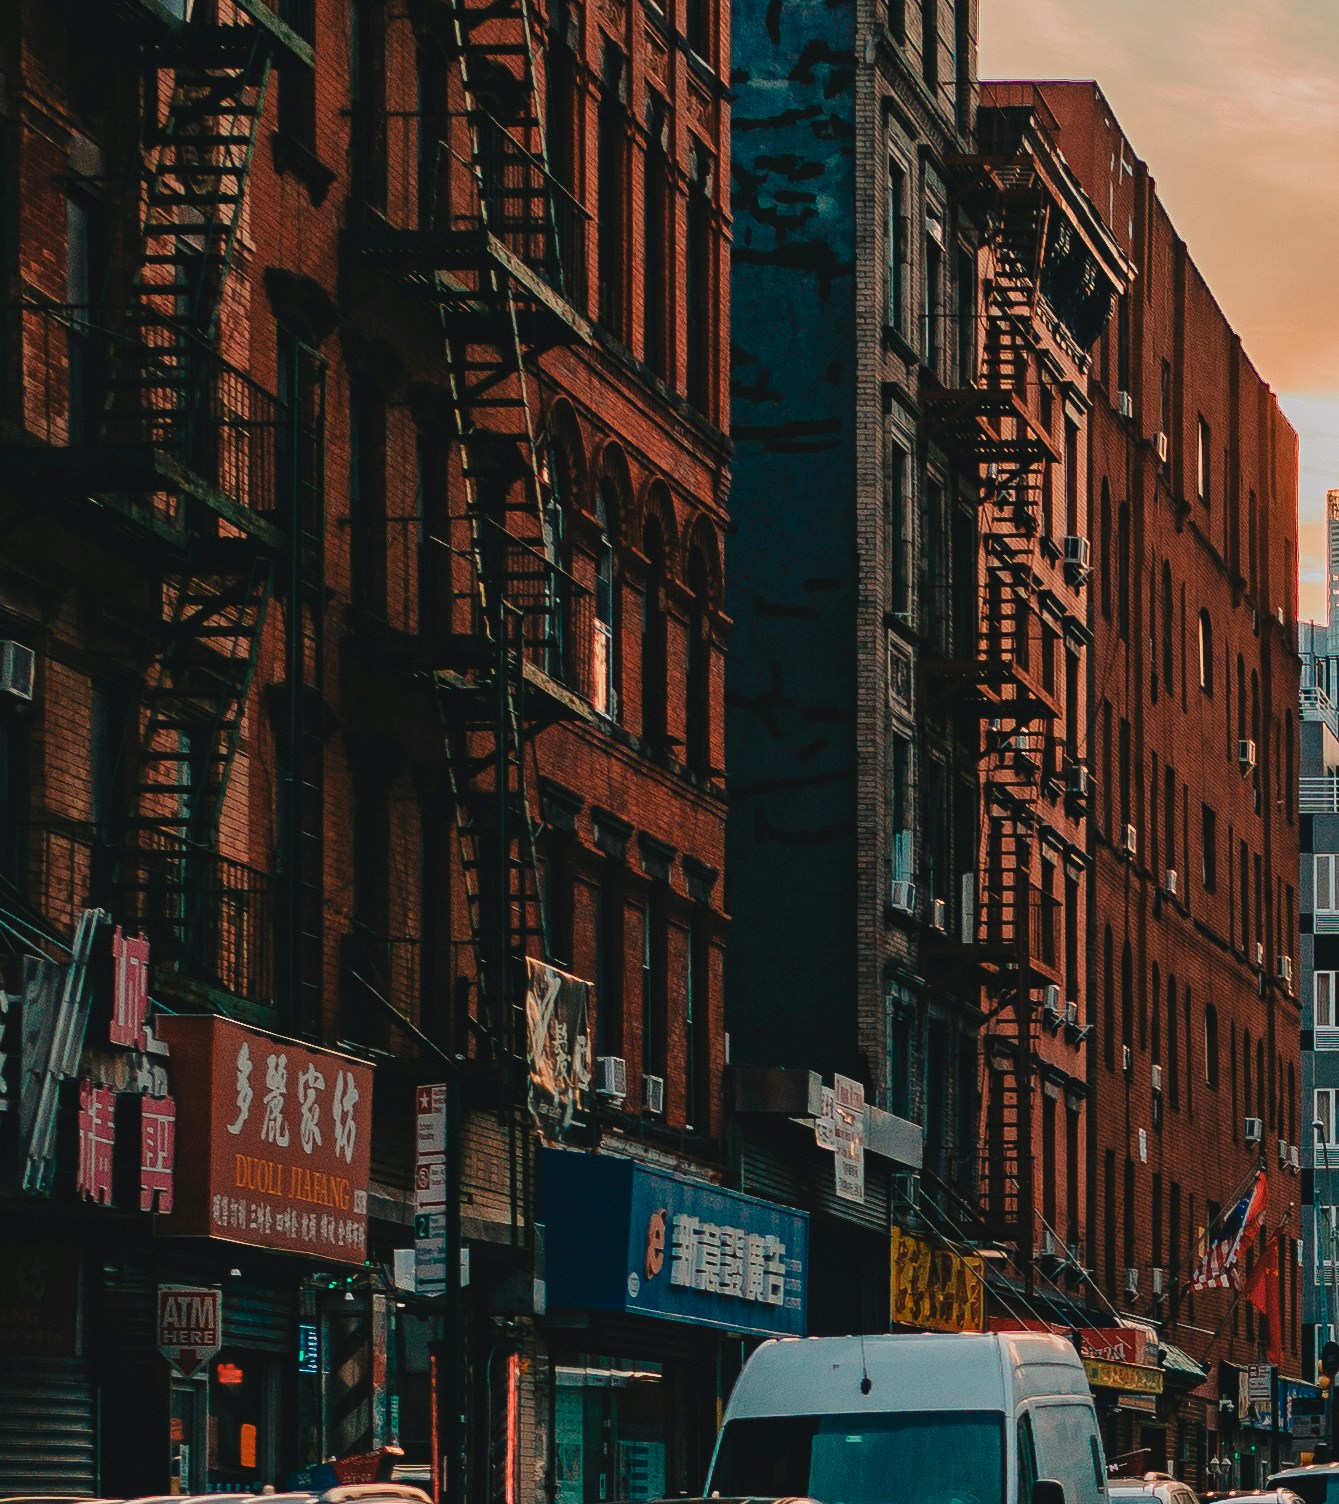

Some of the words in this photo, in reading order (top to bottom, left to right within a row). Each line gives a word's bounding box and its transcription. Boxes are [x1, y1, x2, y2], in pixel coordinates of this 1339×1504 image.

[235, 1153, 283, 1197] DUOLI
[288, 1166, 351, 1211] JIAFANG
[162, 1296, 215, 1329] ATM
[162, 1331, 215, 1344] HERE
